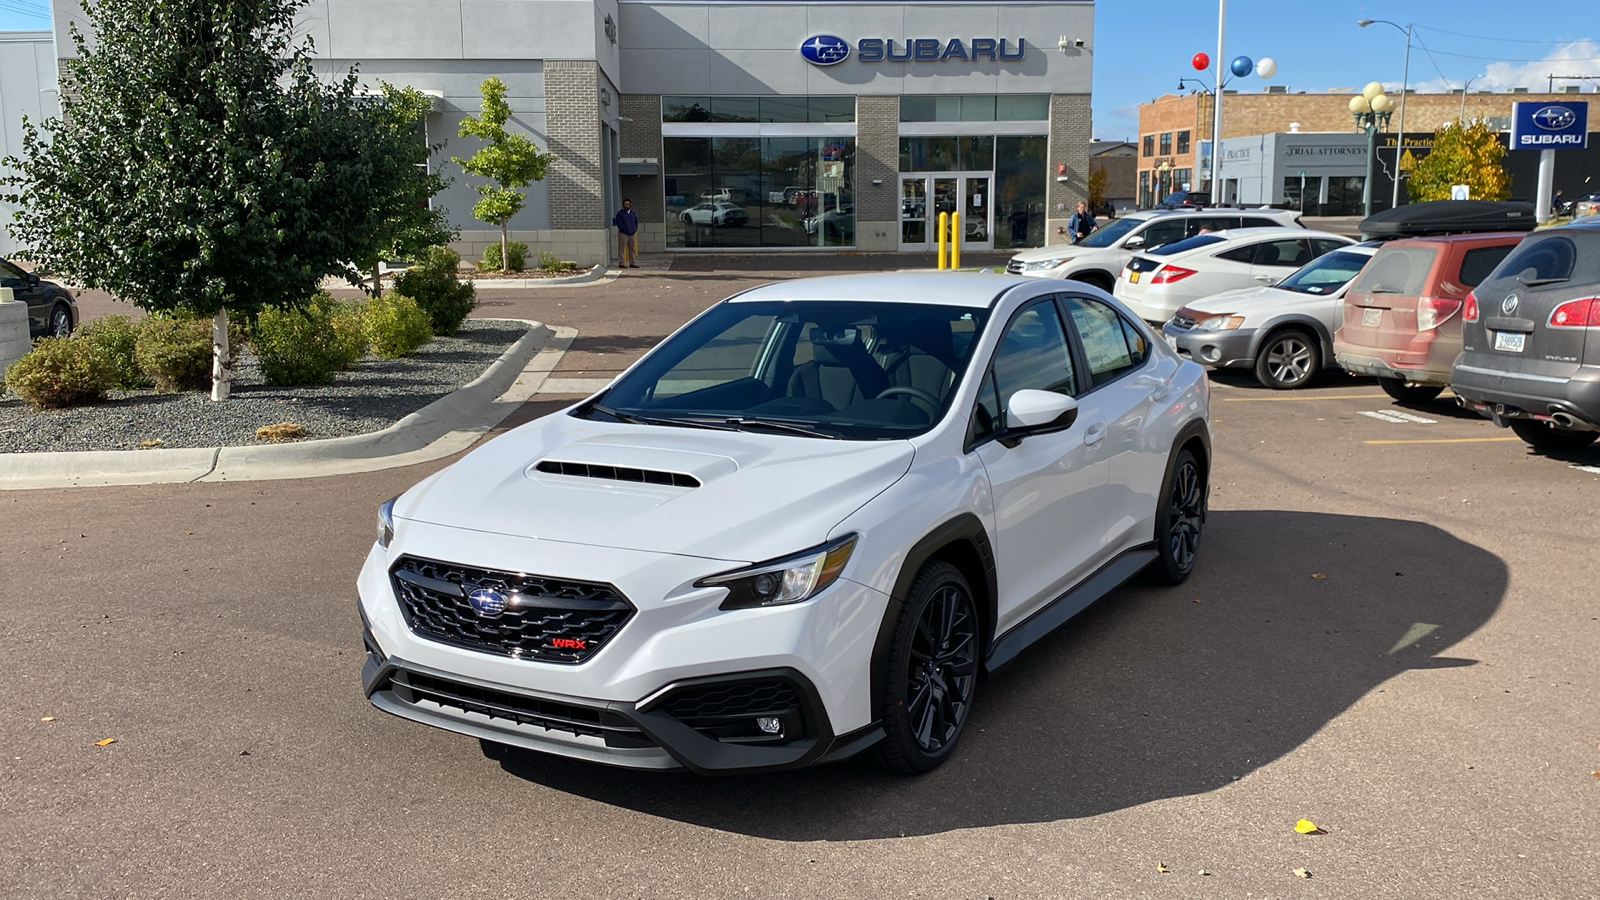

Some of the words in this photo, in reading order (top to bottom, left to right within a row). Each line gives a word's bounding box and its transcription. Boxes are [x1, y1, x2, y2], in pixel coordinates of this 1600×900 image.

[857, 38, 1025, 62] SUBARU
[1521, 134, 1582, 145] SUBARU
[1227, 149, 1251, 159] PRACTICE
[1289, 147, 1316, 156] TRIAL
[1317, 147, 1368, 156] ATTORNEYS
[552, 638, 586, 650] WRX
